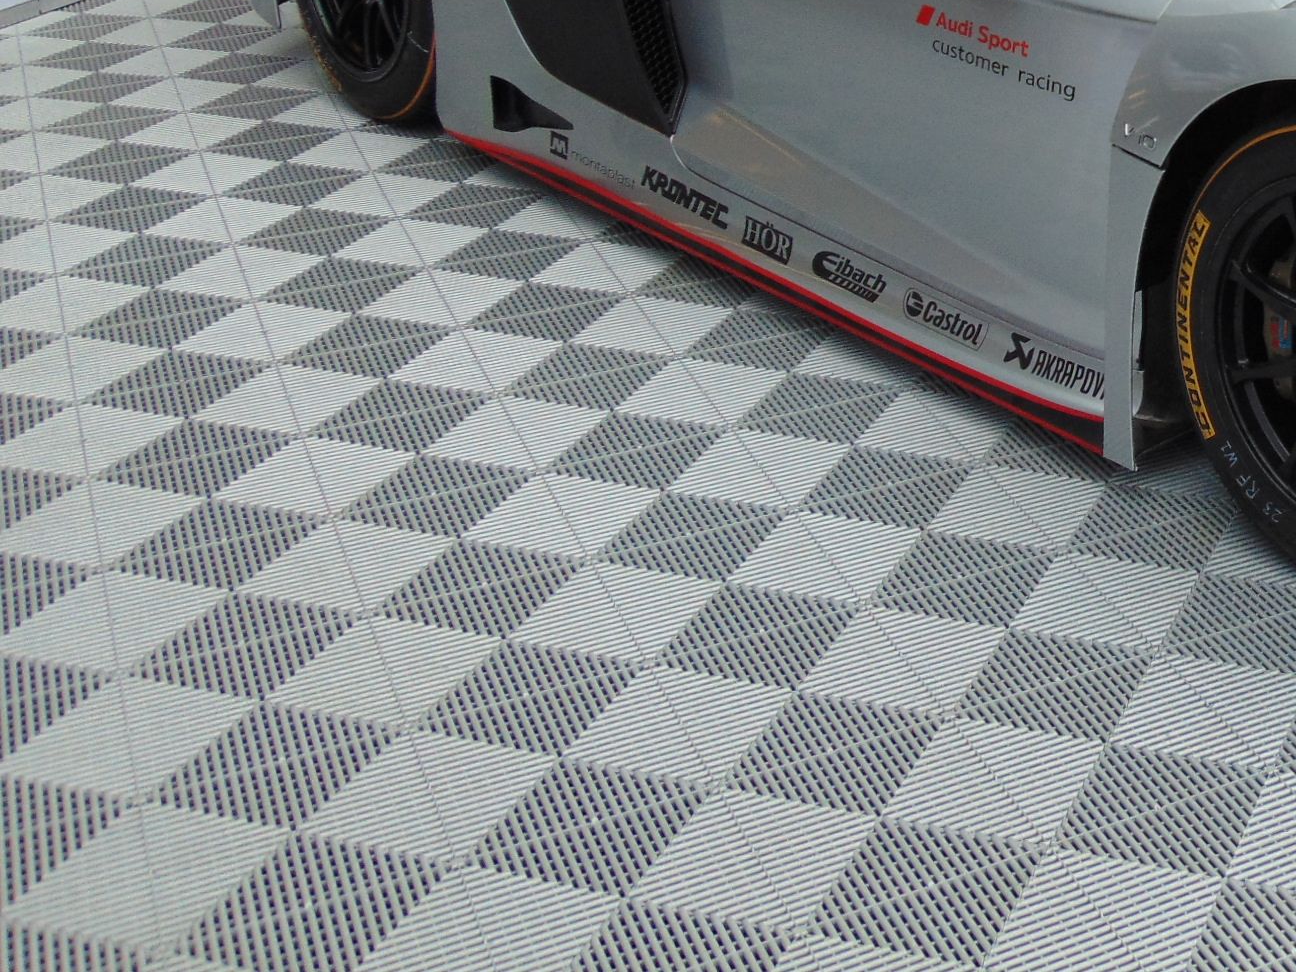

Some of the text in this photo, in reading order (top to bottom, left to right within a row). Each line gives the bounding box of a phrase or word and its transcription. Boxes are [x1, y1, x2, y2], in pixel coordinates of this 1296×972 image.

[936, 12, 1029, 58] Audi Sport
[932, 40, 1076, 102] customer racing
[640, 165, 729, 229] KRONTEC
[745, 219, 792, 261] HÖR
[812, 251, 887, 294] Eibach
[921, 300, 983, 345] Castrol
[1177, 219, 1210, 434] CONTINENTAL
[1031, 349, 1104, 400] AKRAPOV
[1235, 475, 1260, 499] RF
